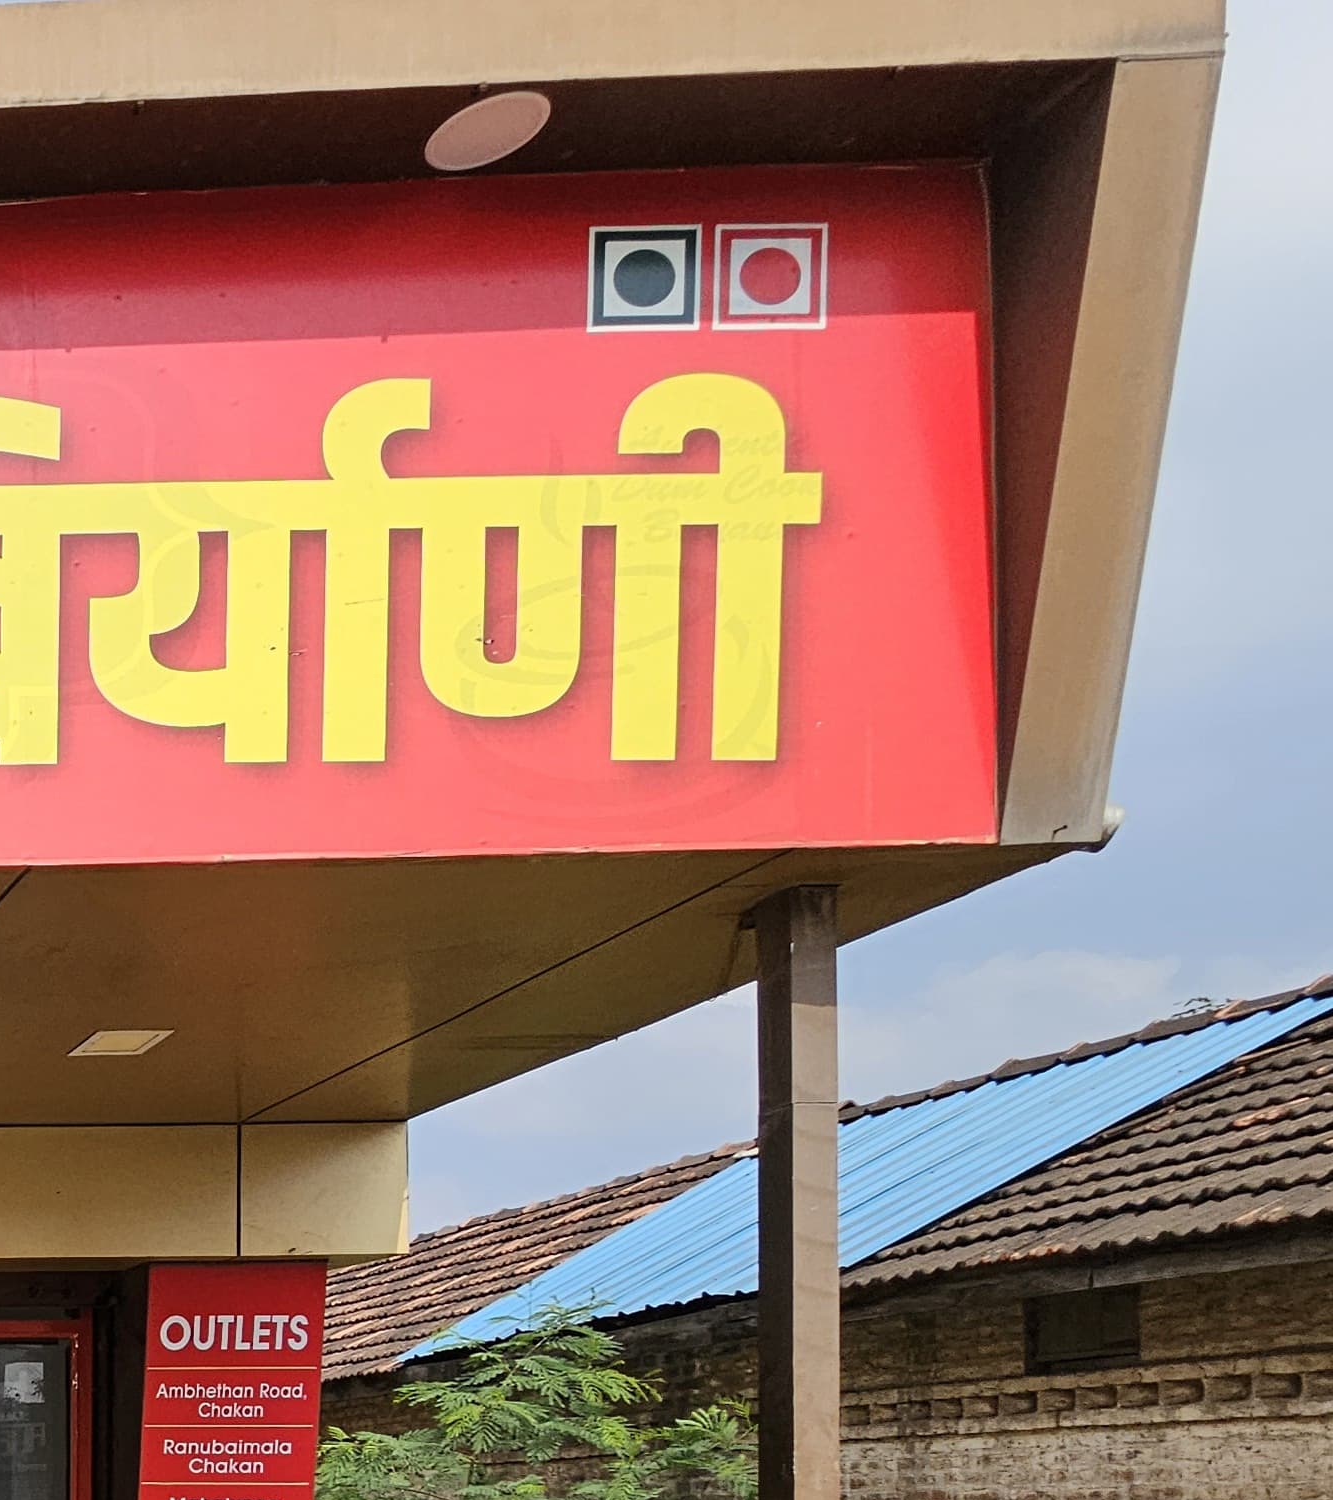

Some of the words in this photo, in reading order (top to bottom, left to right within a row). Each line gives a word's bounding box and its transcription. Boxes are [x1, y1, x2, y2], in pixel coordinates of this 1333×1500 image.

[159, 1314, 310, 1351] OUTLETS
[155, 1382, 254, 1399] Ambhethan
[259, 1382, 307, 1401] Road,
[197, 1402, 264, 1418] Chakan
[162, 1439, 292, 1455] Ranubaimala
[188, 1458, 264, 1474] Chakan
